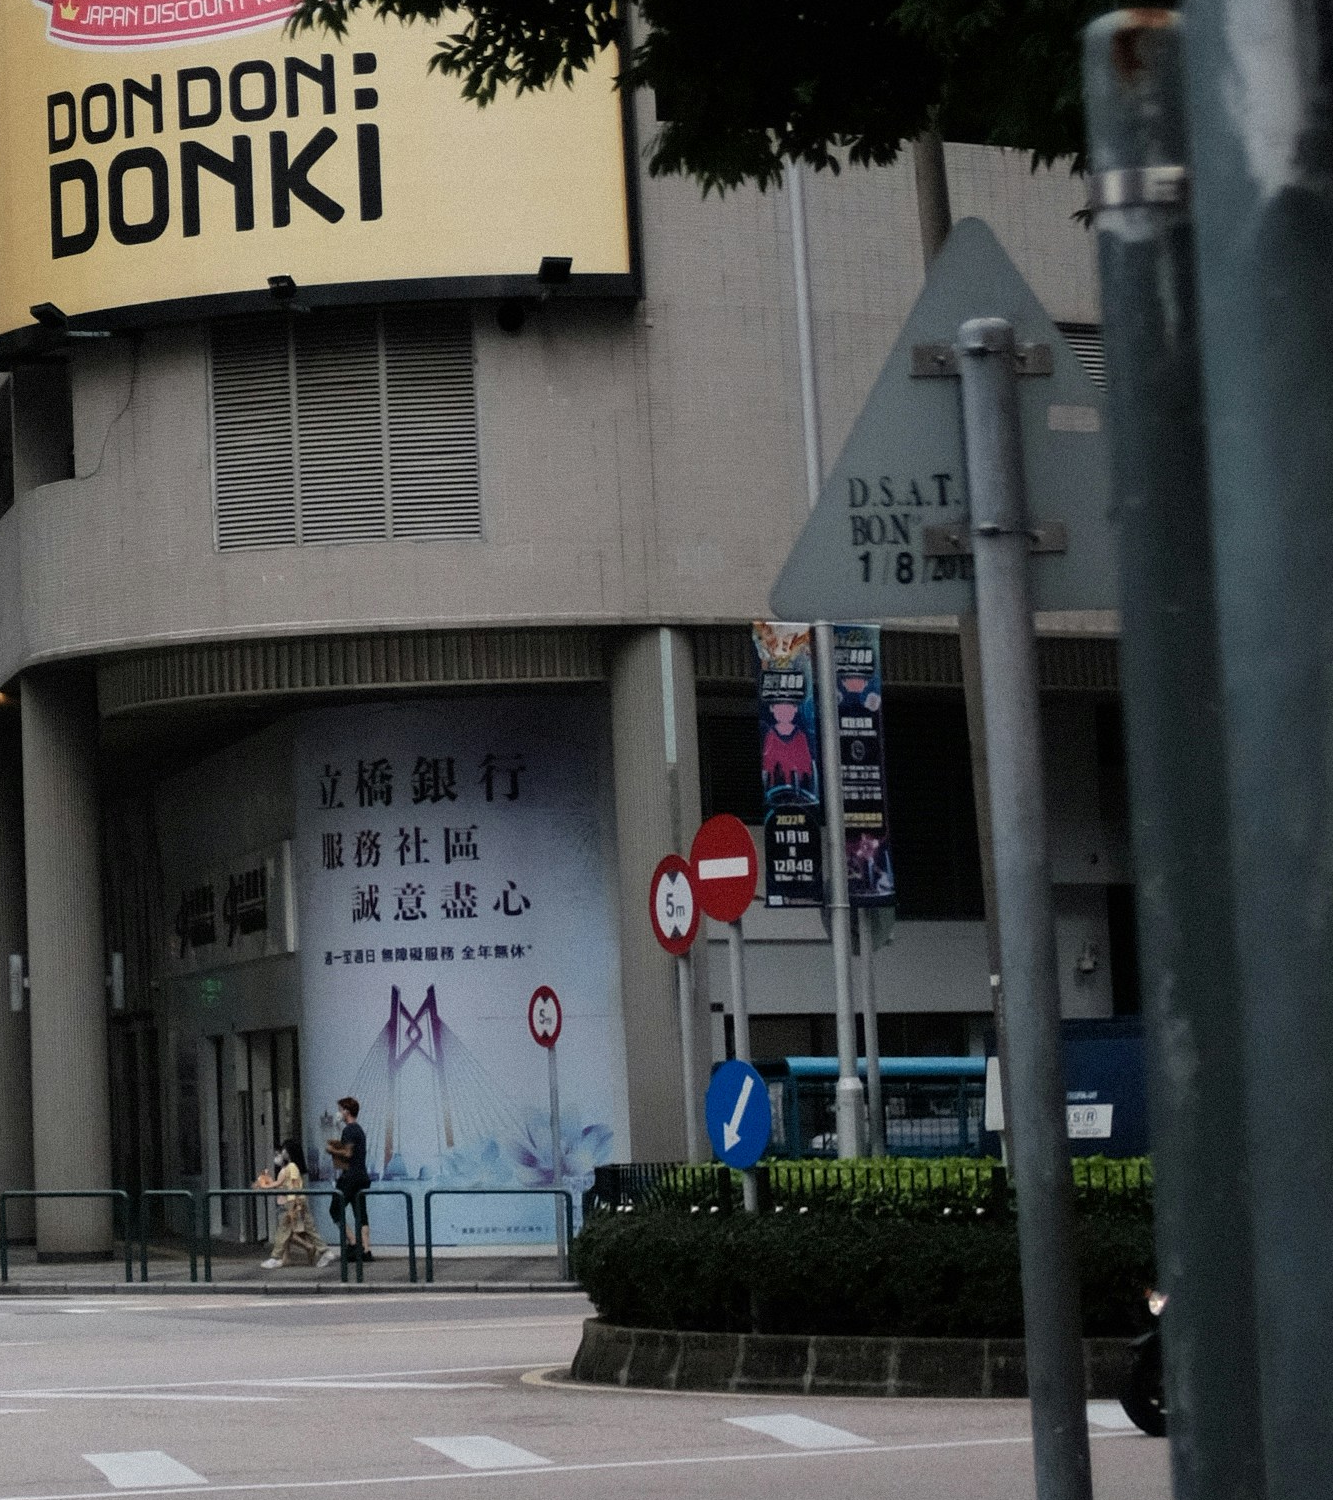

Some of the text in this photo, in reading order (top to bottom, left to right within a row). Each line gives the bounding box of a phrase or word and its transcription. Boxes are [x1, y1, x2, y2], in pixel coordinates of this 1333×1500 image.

[80, 4, 139, 29] JAPAN
[46, 53, 337, 155] DON DON
[49, 122, 384, 260] DONKI
[318, 753, 527, 810] 立橋銀行
[321, 824, 481, 871] 服務社區
[351, 880, 531, 924] 誠意盡心
